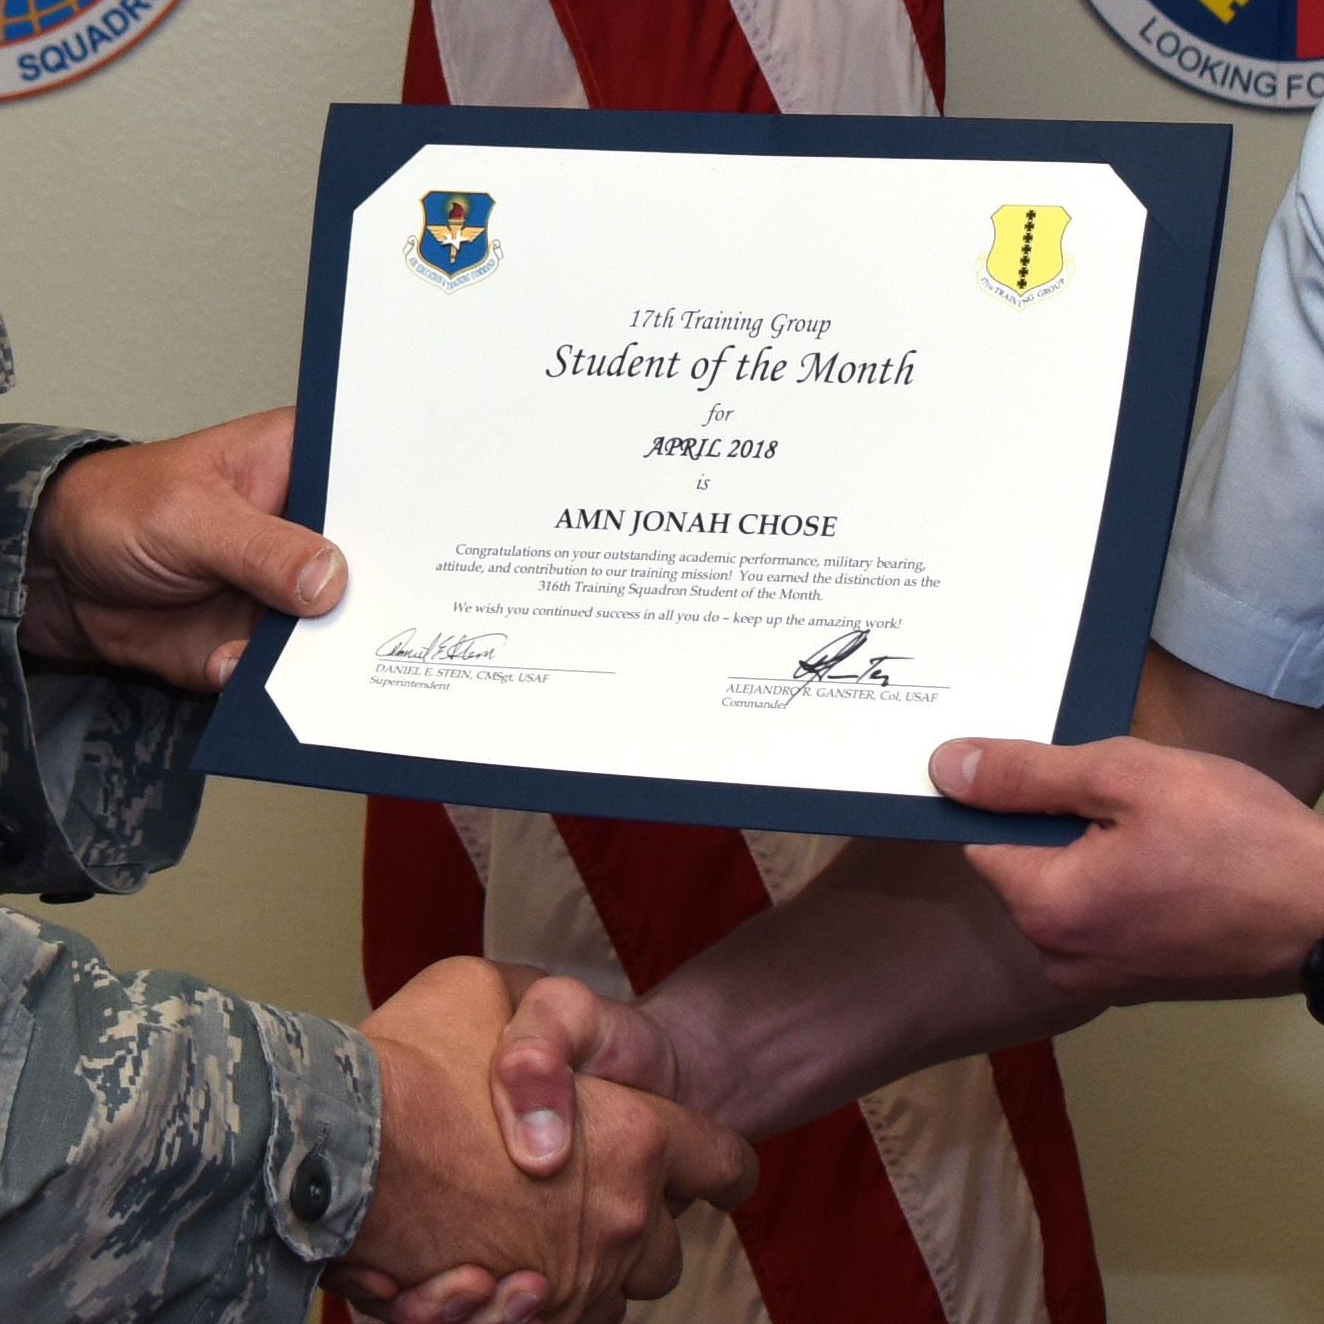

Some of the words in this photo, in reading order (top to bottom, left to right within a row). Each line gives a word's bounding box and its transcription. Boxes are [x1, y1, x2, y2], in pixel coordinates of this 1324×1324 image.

[1138, 16, 1277, 98] LOOKING
[1037, 277, 1066, 298] GROUP
[628, 307, 676, 330] 17th
[680, 310, 763, 338] Training
[770, 312, 832, 340] Group
[545, 342, 682, 379] Student
[690, 344, 736, 392] of
[736, 345, 788, 382] the
[796, 349, 918, 386] Month
[700, 402, 735, 427] for
[642, 435, 722, 461] APRIL
[726, 439, 779, 460] 2018
[695, 473, 711, 491] is
[553, 507, 626, 532] AMN
[628, 509, 732, 537] JONAH
[738, 512, 838, 537] CHOSE
[455, 543, 552, 560] Congratulations
[554, 549, 570, 558] on
[571, 549, 602, 562] your
[604, 549, 676, 565] outstanding
[678, 552, 737, 564] academic
[738, 553, 820, 568] performance,
[823, 556, 873, 571] military
[876, 557, 926, 574] bearing,
[435, 560, 485, 574] attitude,
[487, 562, 511, 574] and
[513, 563, 588, 577] contribution
[591, 566, 603, 577] to
[605, 568, 627, 578] our
[630, 566, 678, 582] training
[680, 569, 733, 581] mission!
[739, 570, 764, 582] You
[766, 572, 810, 584] earned
[812, 572, 832, 584] the
[834, 573, 900, 587] distinction
[903, 578, 918, 588] as
[920, 576, 941, 588] the
[537, 580, 571, 593] 316th
[574, 581, 626, 597] Training
[627, 583, 687, 598] Squadron
[689, 585, 738, 599] Student
[740, 587, 755, 601] of
[757, 587, 777, 600] the
[778, 588, 823, 602] Month.
[453, 601, 473, 613] We
[475, 602, 504, 615] wish
[506, 606, 529, 618] you
[532, 605, 593, 618] continued
[595, 609, 641, 620] success
[643, 608, 655, 621] in
[658, 609, 674, 622] all
[676, 612, 700, 625] you
[703, 611, 720, 623] do
[733, 612, 763, 627] keep
[766, 615, 784, 628] up
[785, 614, 806, 626] the
[807, 616, 862, 632] amazing
[864, 618, 902, 630] work!
[369, 675, 451, 691] Superintendent
[375, 663, 422, 676] DANIEL
[517, 672, 550, 684] USAF
[721, 696, 789, 710] Commander
[725, 682, 800, 697] ALEJANDRO
[905, 692, 939, 704] USAF
